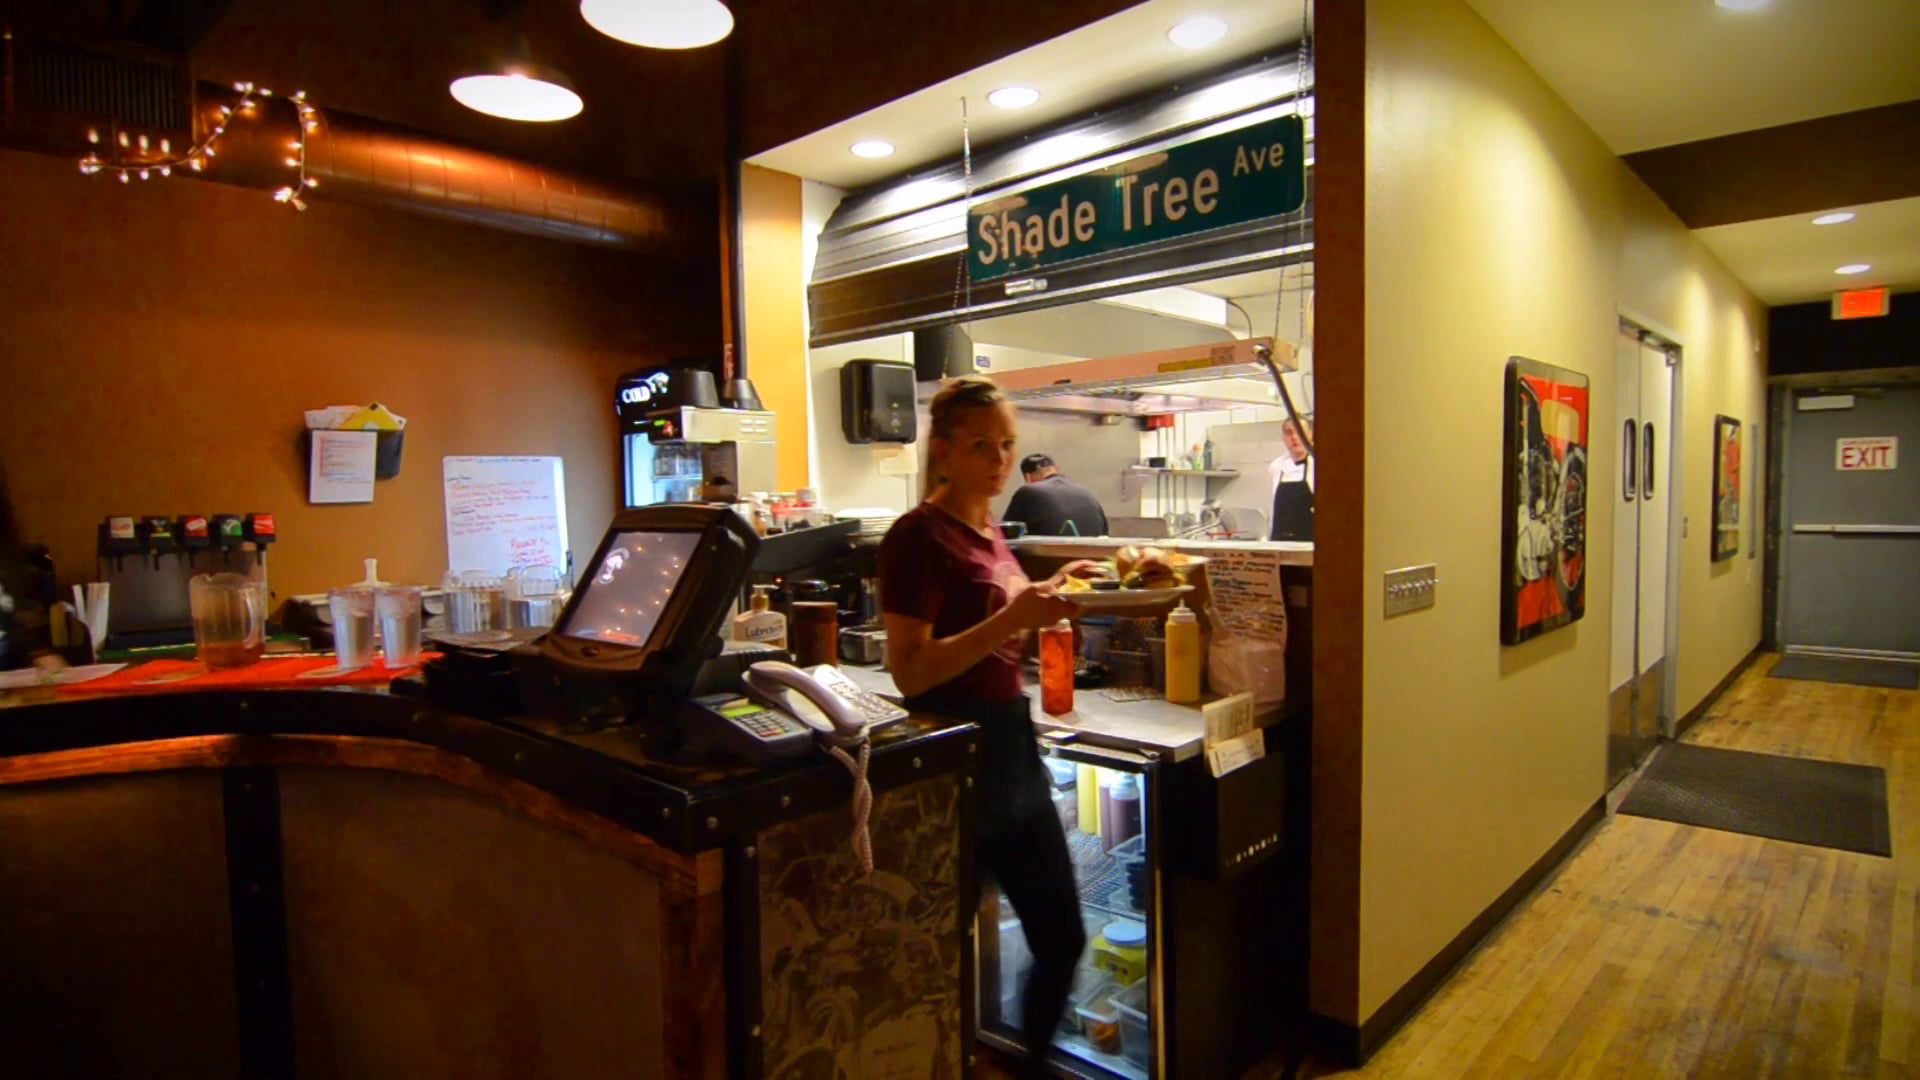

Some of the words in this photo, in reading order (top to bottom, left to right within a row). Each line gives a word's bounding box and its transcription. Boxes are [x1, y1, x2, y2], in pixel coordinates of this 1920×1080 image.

[978, 193, 1096, 265] Shade
[1115, 168, 1220, 231] Tree
[1233, 142, 1285, 177] Ave
[1842, 446, 1891, 468] EXIT
